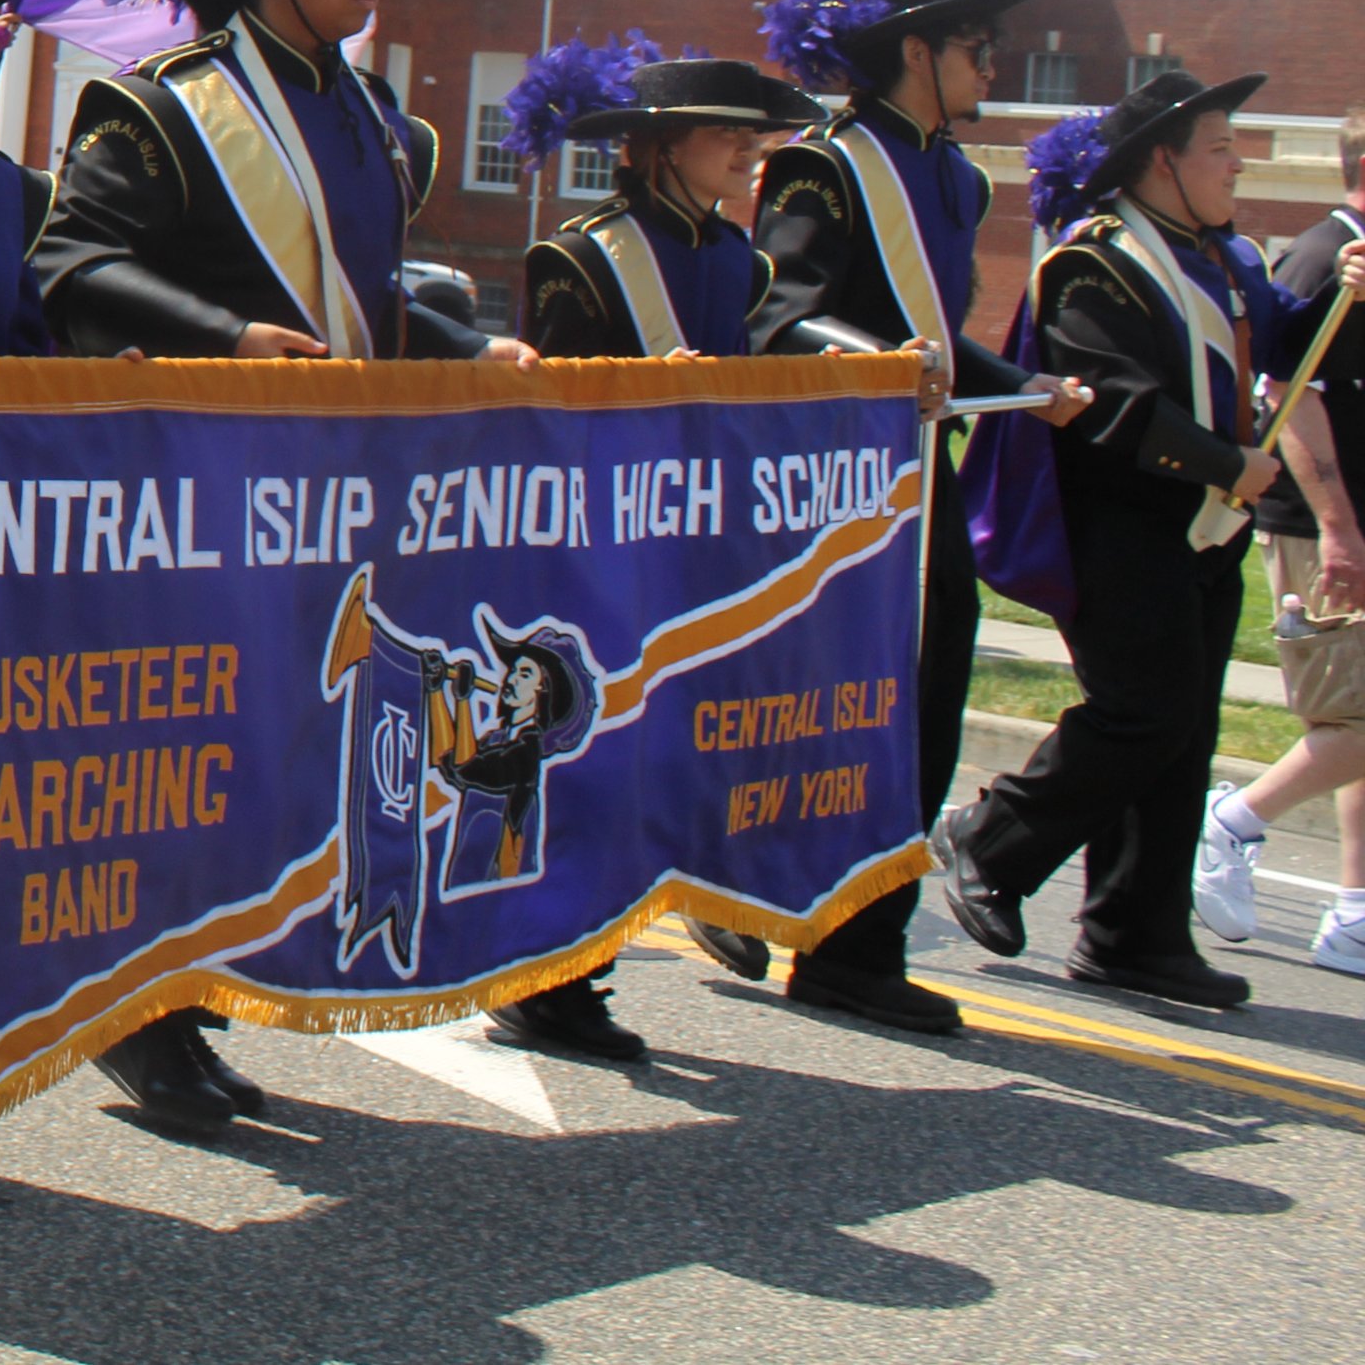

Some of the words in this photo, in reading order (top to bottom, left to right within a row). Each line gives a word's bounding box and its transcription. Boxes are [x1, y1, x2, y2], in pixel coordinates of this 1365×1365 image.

[245, 476, 374, 567] ISLIP
[397, 464, 591, 555] SENIOR
[613, 458, 722, 544] HIGH
[753, 447, 897, 533] SCHOOL
[694, 694, 824, 752] CENTRAL
[833, 677, 898, 732] ISLIP
[726, 775, 789, 836] NEW
[799, 763, 868, 819] YORK
[20, 859, 138, 945] BAND
